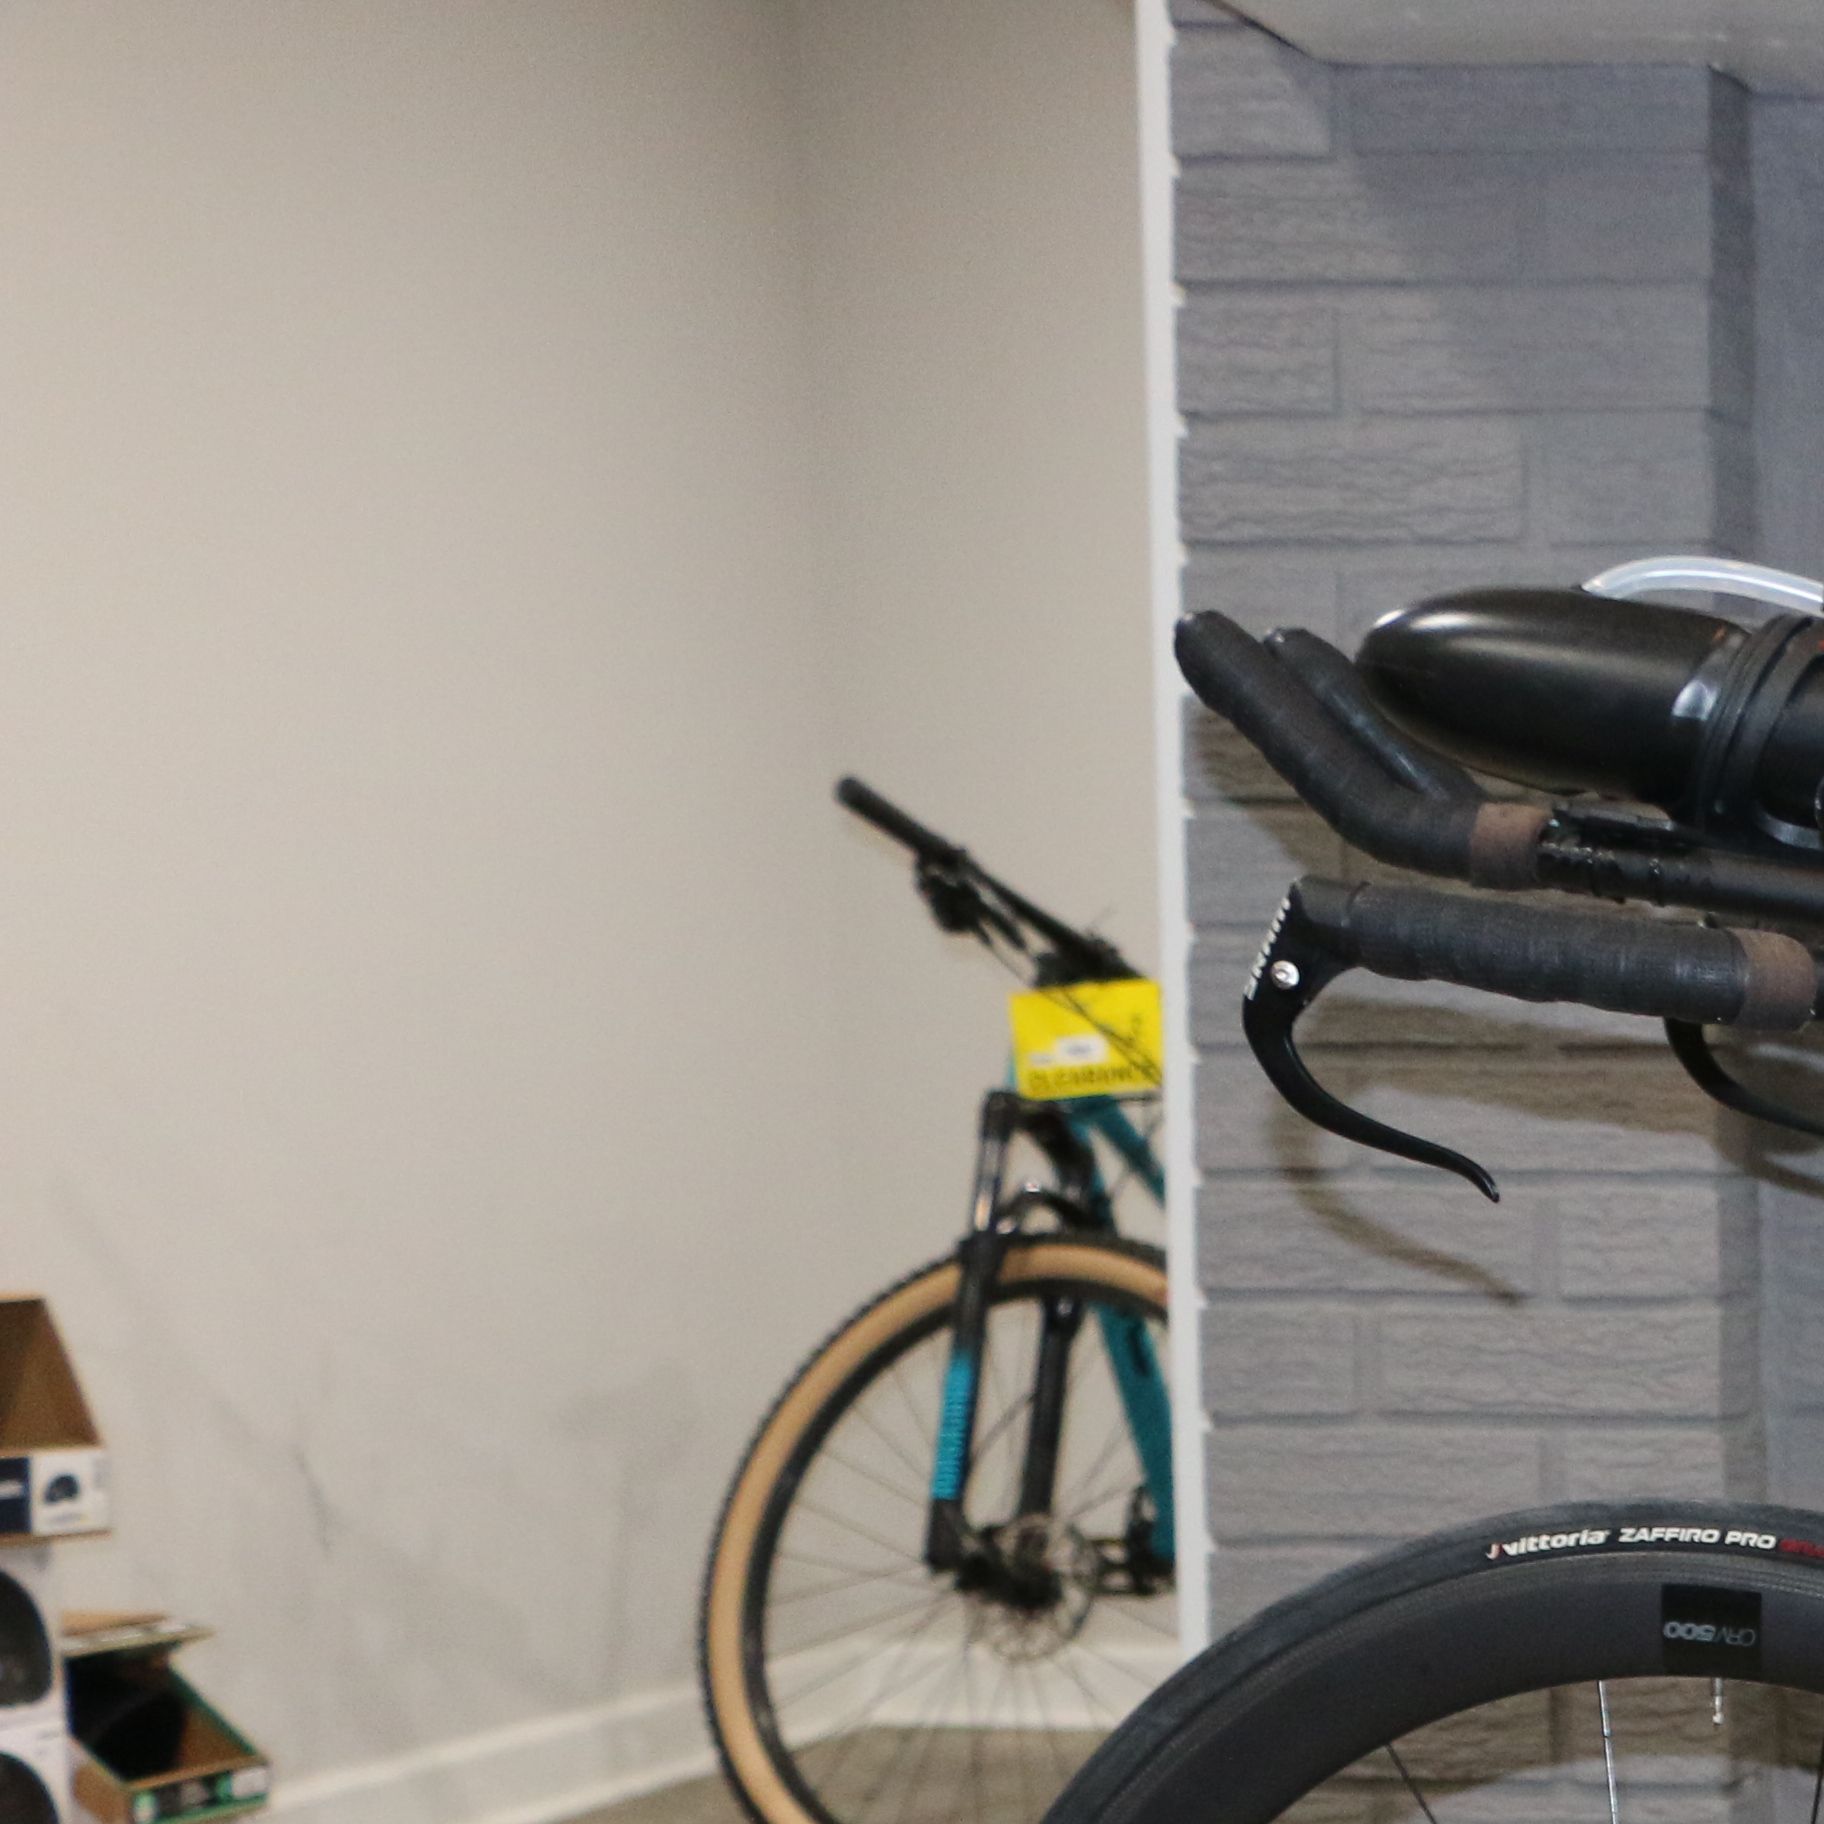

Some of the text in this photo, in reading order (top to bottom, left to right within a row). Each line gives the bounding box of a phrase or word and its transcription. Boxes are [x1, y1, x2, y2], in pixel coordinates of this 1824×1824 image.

[1501, 1527, 1777, 1556] vittoria ZAFFIRO PRO
